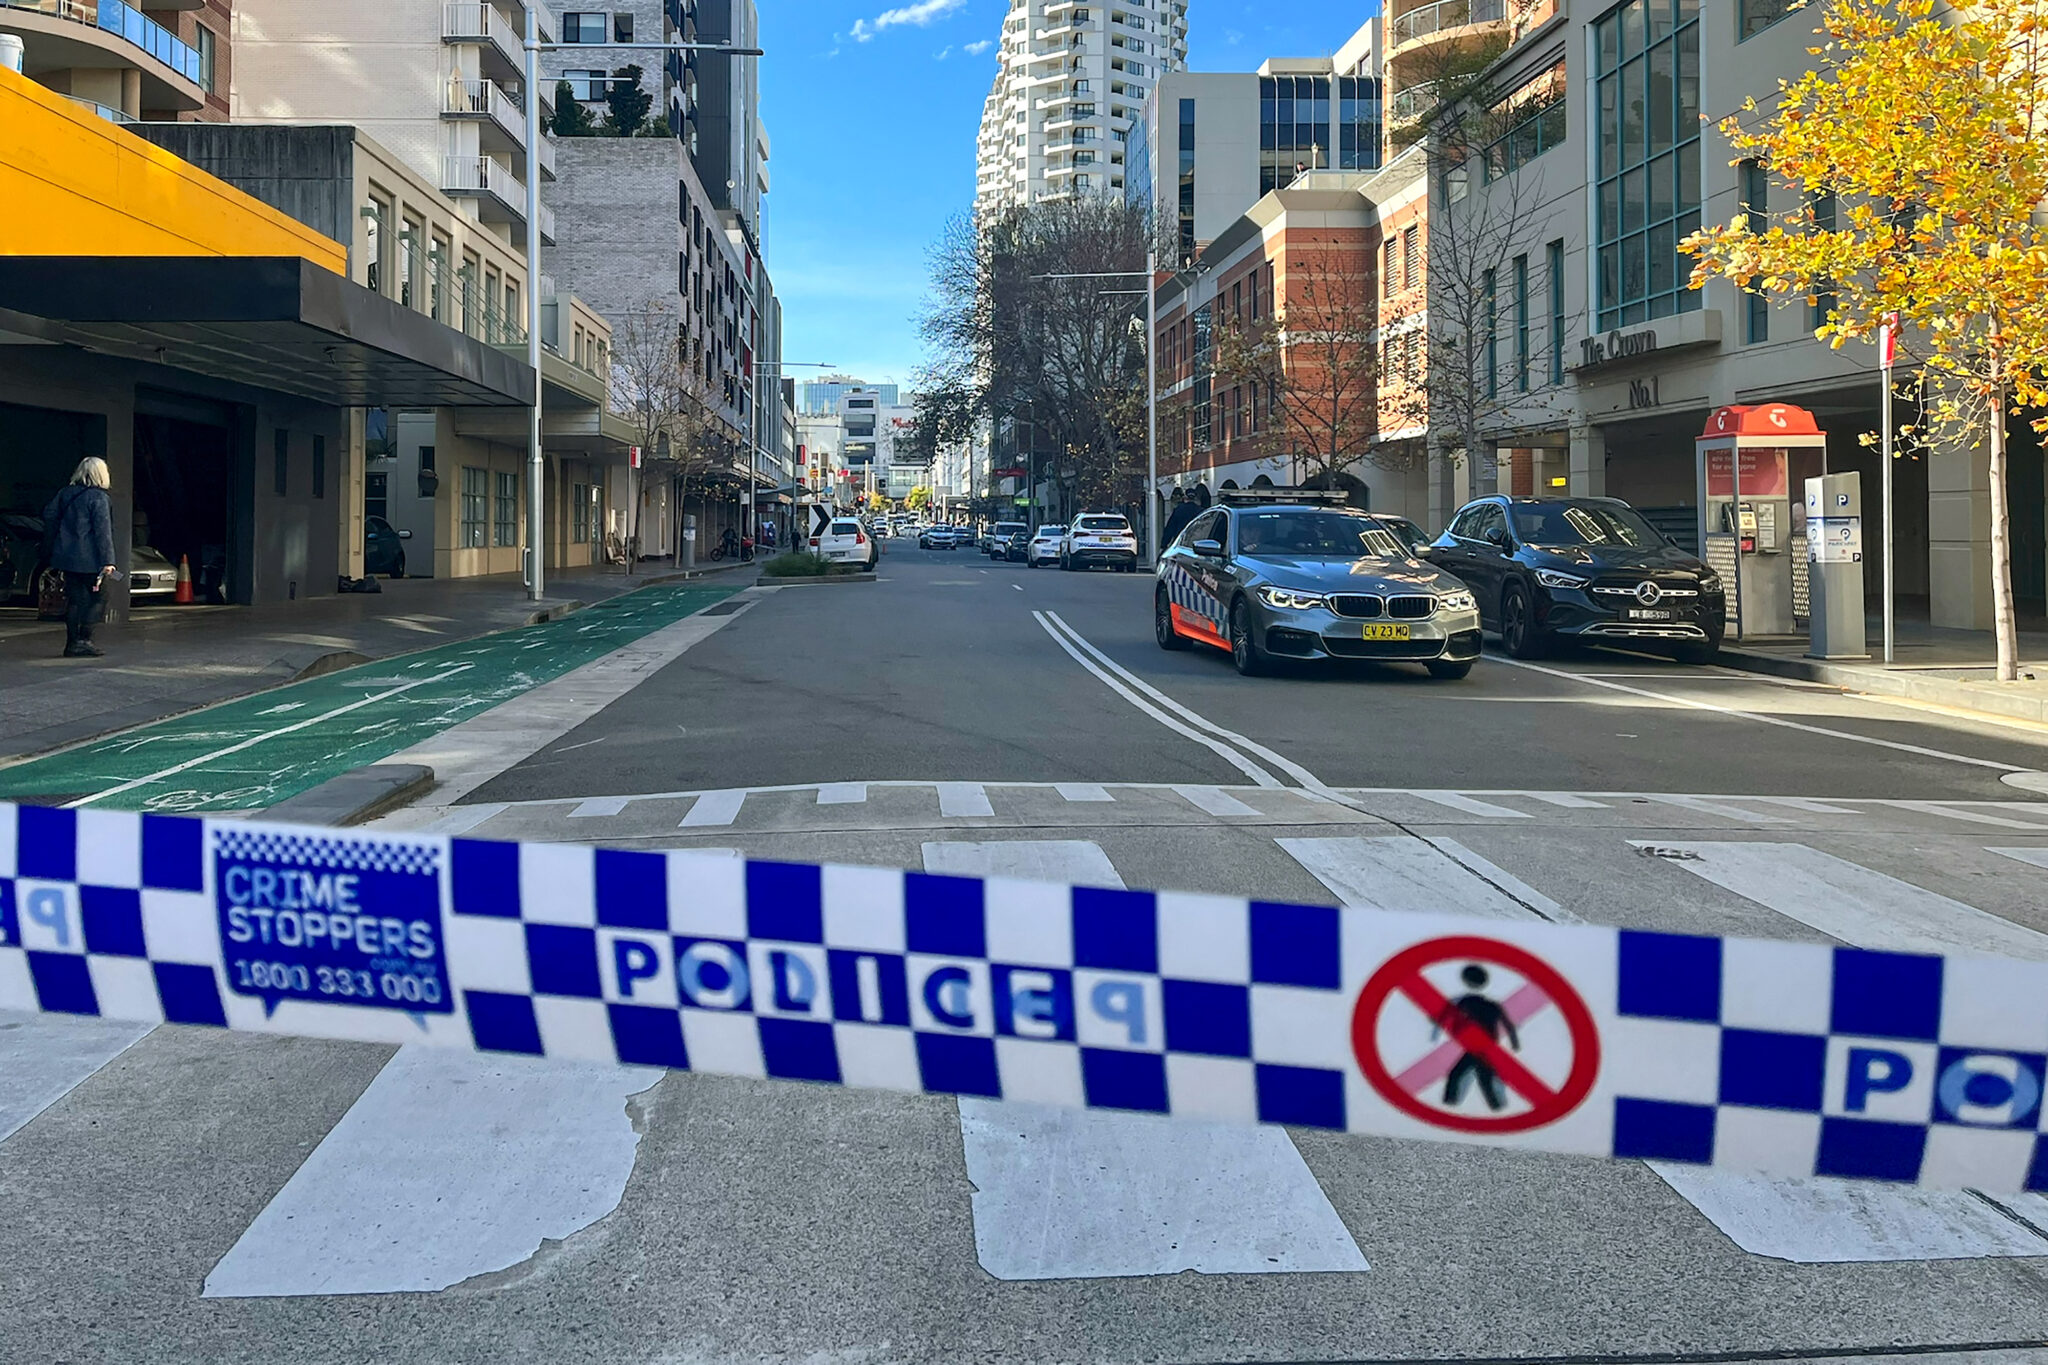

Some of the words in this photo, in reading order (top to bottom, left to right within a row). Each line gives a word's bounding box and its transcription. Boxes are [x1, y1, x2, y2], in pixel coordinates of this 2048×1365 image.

[1580, 335, 1605, 364] The
[1607, 329, 1658, 359] Crown
[1629, 375, 1660, 409] No.1
[1723, 463, 1756, 472] evyone
[1364, 625, 1377, 636] CV
[1380, 625, 1393, 637] 23
[225, 865, 362, 913] CRIME
[228, 905, 436, 959] STOPPERS
[234, 959, 311, 991] 1800
[315, 965, 375, 998] 333
[380, 972, 442, 1004] 000
[612, 938, 1058, 1038] POLICE
